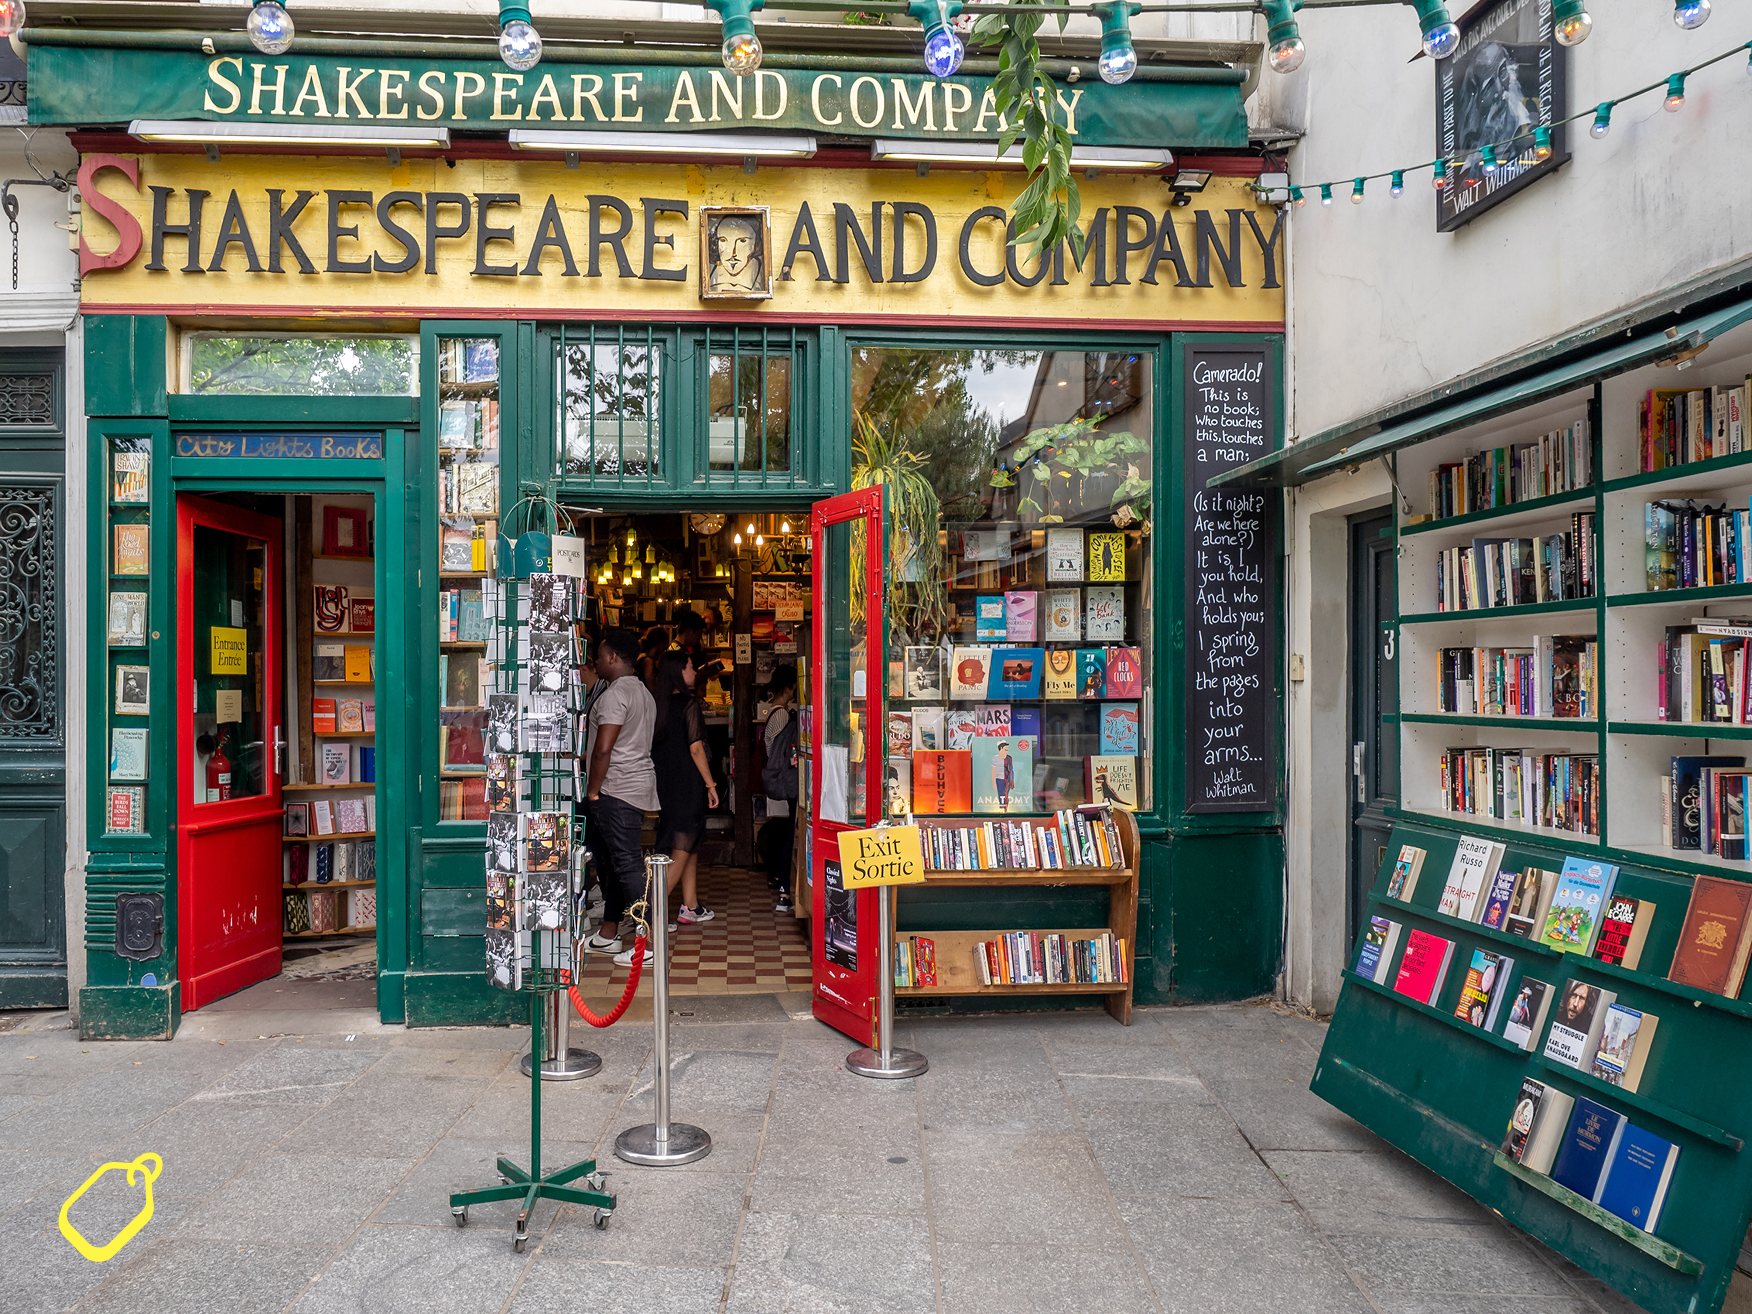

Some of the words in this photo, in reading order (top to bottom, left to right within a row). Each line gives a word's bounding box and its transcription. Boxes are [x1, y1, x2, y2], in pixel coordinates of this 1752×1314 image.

[203, 56, 643, 123] SHAKESPEARE
[665, 69, 788, 123] AND
[1454, 180, 1483, 215] WALT
[1485, 147, 1538, 196] WHITMAN
[79, 154, 689, 281] SHAKESPEARE
[777, 200, 938, 284] AND
[959, 205, 1286, 289] COMPANY
[1193, 361, 1263, 384] Camerado!
[1199, 387, 1230, 401] This
[1236, 387, 1249, 401] is
[1204, 404, 1219, 414] no
[1223, 402, 1260, 416] book;
[1220, 415, 1263, 429] touches
[1196, 429, 1221, 443] this,
[1222, 430, 1263, 445] touches
[177, 435, 236, 458] City
[241, 436, 314, 458] Lights
[1197, 449, 1207, 462] a
[1215, 448, 1250, 462] man;
[116, 461, 141, 470] SHAW
[1193, 491, 1208, 513] (Is
[1212, 492, 1222, 512] it
[1226, 495, 1264, 518] night?
[1194, 515, 1214, 532] Are
[1217, 519, 1232, 530] we
[1233, 516, 1260, 531] here
[1091, 534, 1108, 552] COME
[1108, 534, 1123, 554] WEST
[1202, 530, 1254, 549] alone?)
[1197, 550, 1208, 568] It
[1218, 551, 1232, 567] is
[1200, 571, 1224, 588] you
[1228, 565, 1263, 584] hold,
[1580, 564, 1588, 585] ELLIS
[1196, 587, 1227, 605] And
[1234, 586, 1258, 603] who
[1096, 600, 1111, 613] Left
[1096, 610, 1115, 620] Bank
[1203, 605, 1237, 625] holds
[1240, 610, 1265, 631] you;
[213, 636, 245, 651] Entrance
[1198, 630, 1203, 650] I
[1213, 631, 1259, 656] spring
[1384, 629, 1395, 661] 3
[218, 652, 242, 667] Entrée
[1118, 661, 1130, 672] RED
[1207, 649, 1244, 673] from
[1113, 671, 1134, 682] CLOCKS
[1196, 671, 1218, 690] the
[1222, 674, 1260, 697] pages
[1046, 681, 1060, 690] Fly
[1063, 681, 1076, 689] Me
[1209, 698, 1243, 719] into
[976, 710, 1011, 726] MARS
[1204, 724, 1244, 748] your
[1204, 745, 1263, 765] arms...
[1112, 765, 1128, 773] LIFE
[1213, 768, 1243, 785] Walt
[1117, 783, 1131, 791] ME
[1205, 782, 1256, 799] Whitman
[976, 796, 1031, 805] ANATOMY
[858, 836, 902, 859] Exit
[1459, 839, 1488, 855] Richard
[1459, 854, 1483, 868] Russo
[852, 858, 914, 881] Sortie
[1499, 870, 1516, 882] Norman
[1563, 871, 1604, 884] Englisch-Wörterbuch
[1497, 879, 1511, 889] Mailer
[1444, 884, 1476, 901] STRAIGHT
[1440, 896, 1455, 910] MAN
[1615, 901, 1633, 914] JOHN
[1613, 922, 1623, 930] THE
[1419, 933, 1429, 944] web
[1605, 932, 1622, 945] LITTLE
[1405, 956, 1426, 968] important
[1412, 949, 1426, 960] most
[1402, 963, 1422, 975] decisions
[1559, 1025, 1585, 1042] STRUGGLE
[1548, 1038, 1560, 1048] KARL
[1560, 1043, 1571, 1052] OVE
[1546, 1045, 1579, 1063] KNAUSGAARD
[1515, 1110, 1529, 1128] 1Q84
[1585, 1117, 1601, 1131] LIVRE
[1590, 1114, 1598, 1123] LE
[1576, 1127, 1602, 1143] MORMON
[1586, 1124, 1595, 1133] DE
